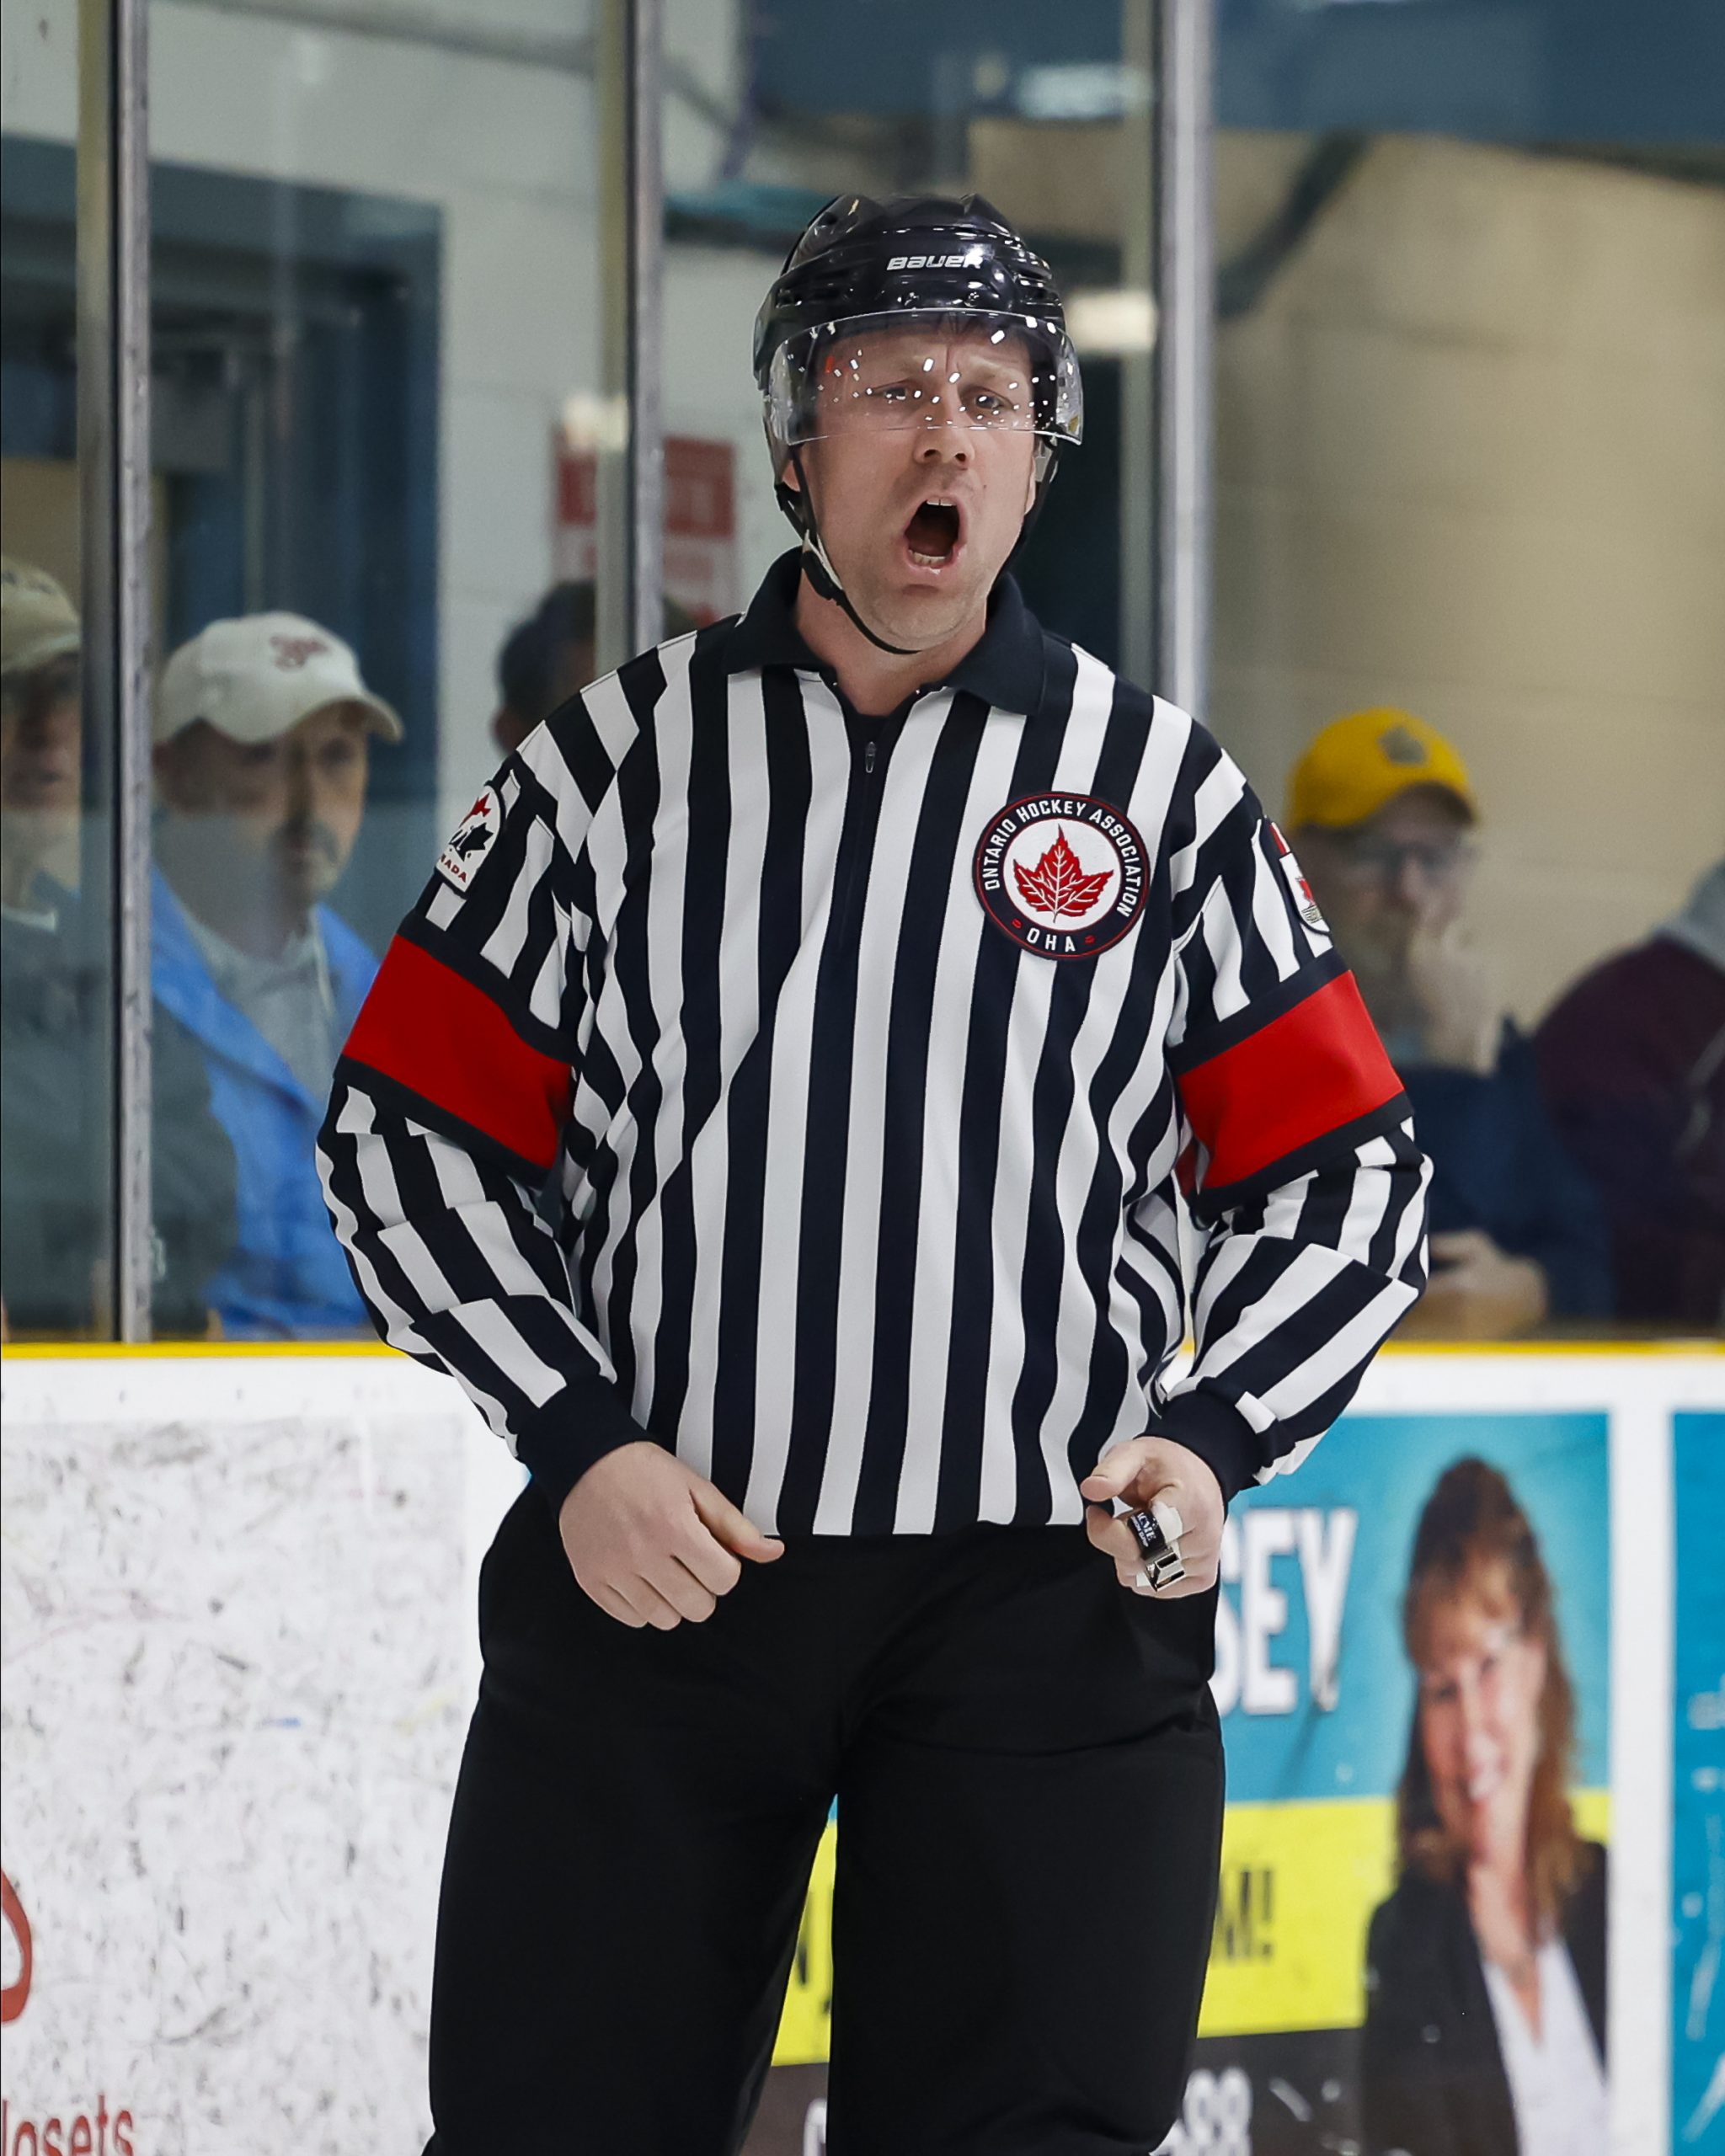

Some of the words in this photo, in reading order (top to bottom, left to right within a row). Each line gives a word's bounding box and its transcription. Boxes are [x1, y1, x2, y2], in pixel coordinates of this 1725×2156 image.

[887, 254, 983, 270] BAUER
[982, 819, 1017, 891] ONTARIO
[1016, 799, 1087, 823] HOCKEY
[1088, 808, 1142, 917] ASSOCIATION
[1026, 927, 1076, 953] OHA
